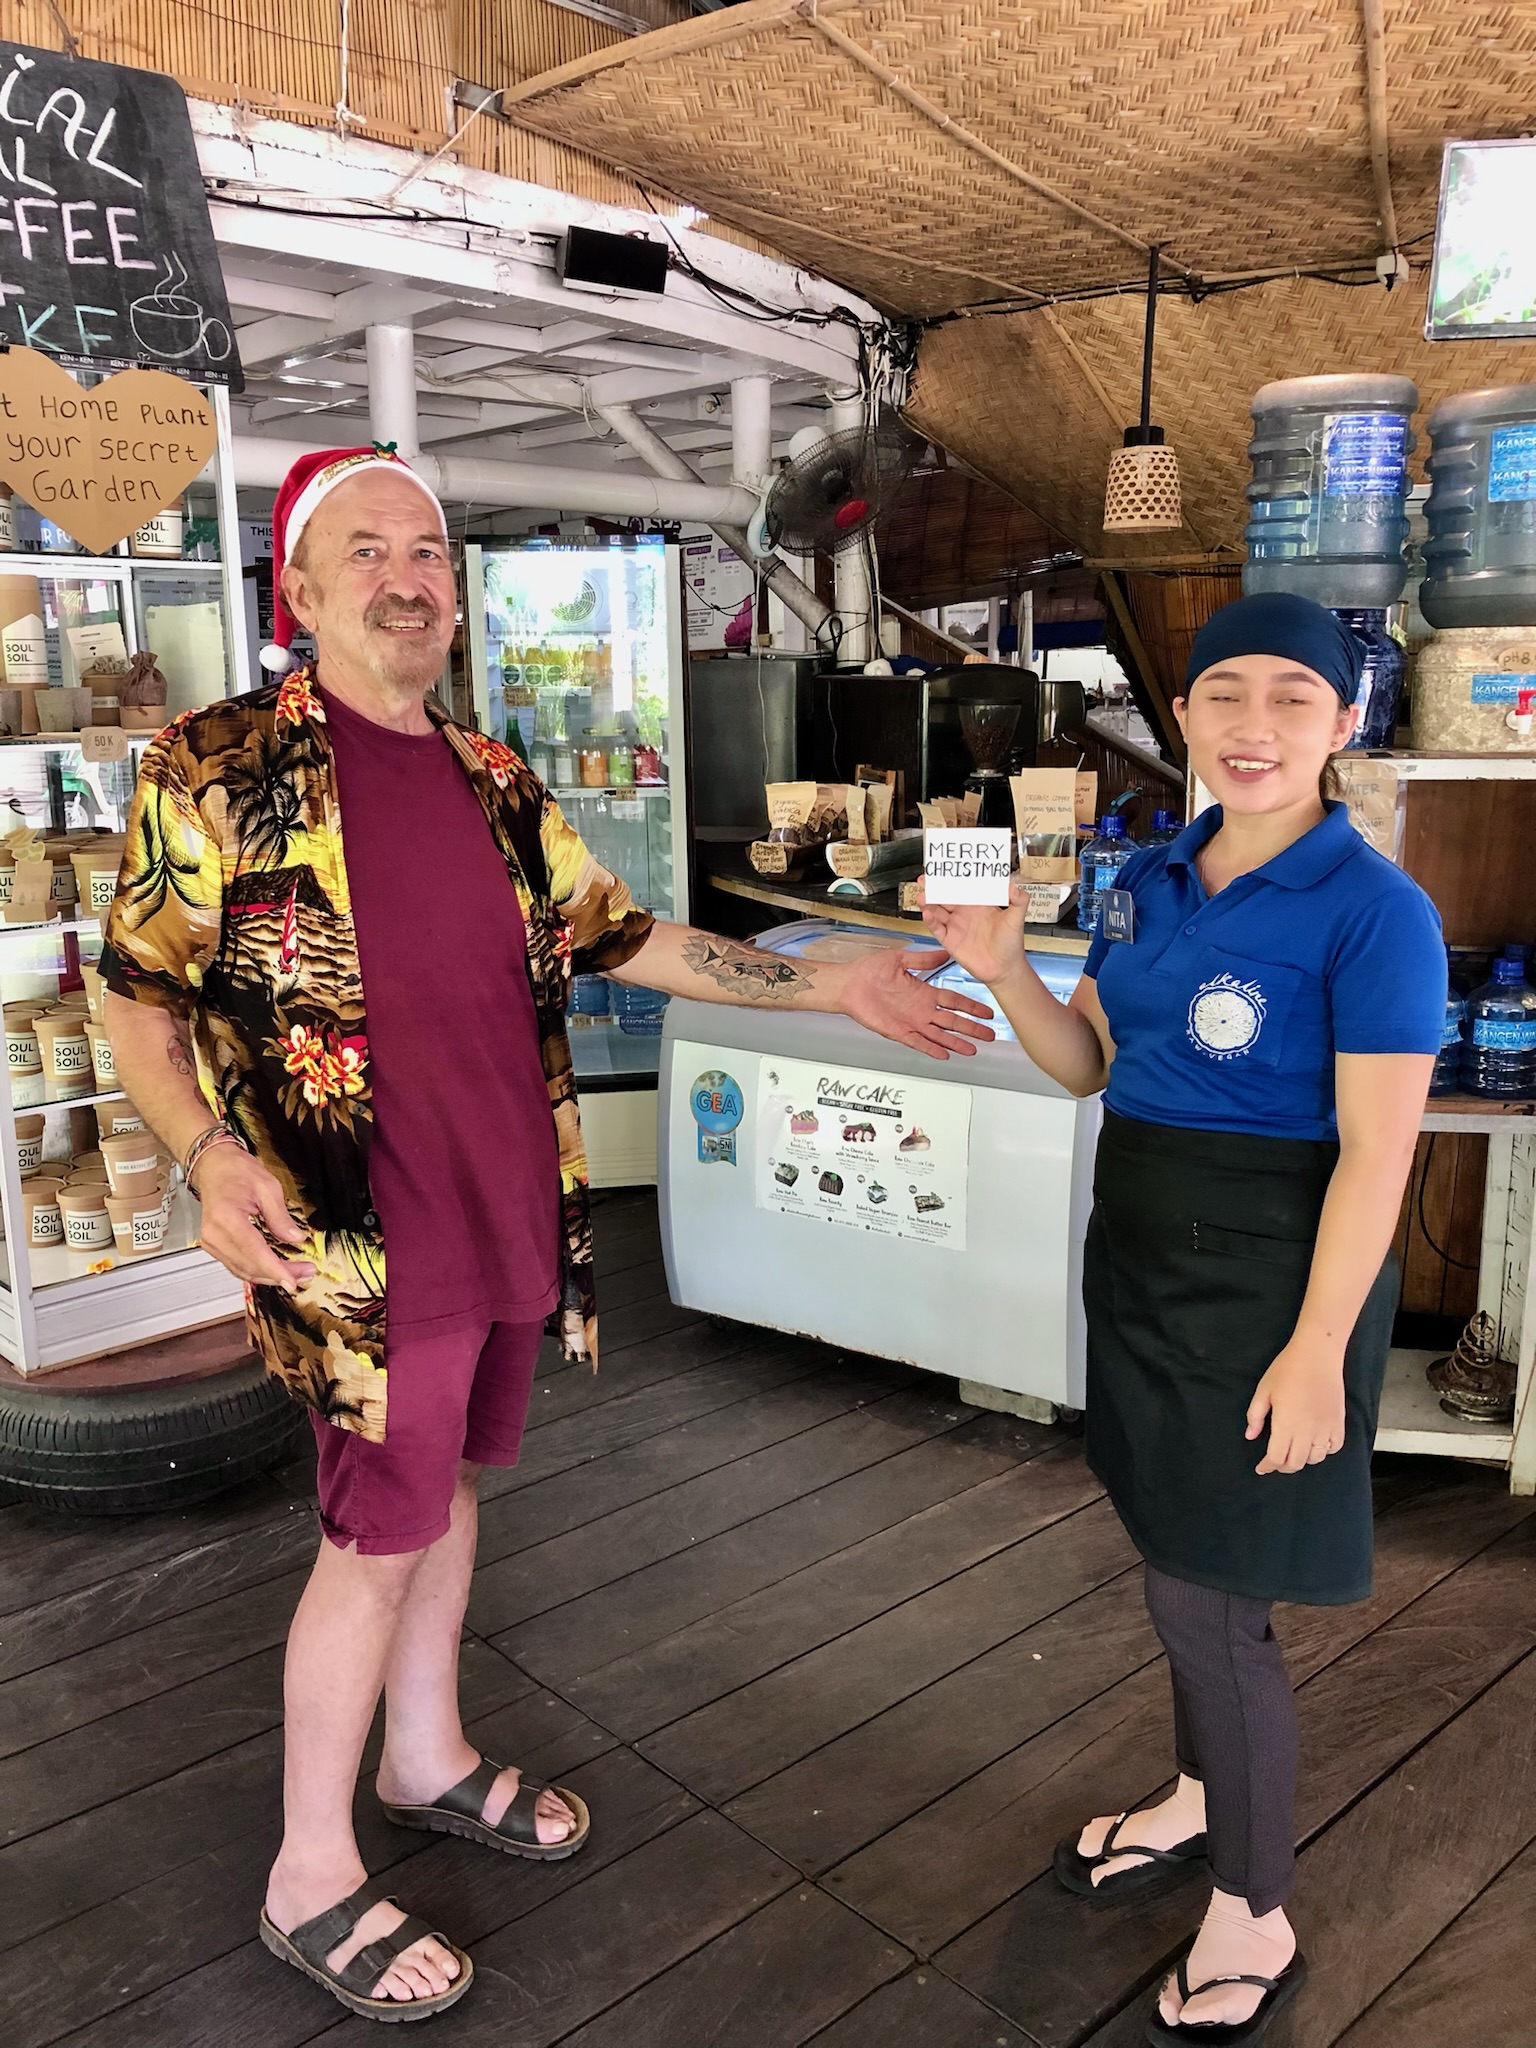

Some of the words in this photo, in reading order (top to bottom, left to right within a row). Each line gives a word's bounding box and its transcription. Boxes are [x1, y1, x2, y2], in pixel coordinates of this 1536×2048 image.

[40, 394, 119, 423] Home
[32, 469, 162, 503] Garden
[929, 842, 1005, 859] MERRY
[925, 861, 1010, 878] CHRISTMAS
[1108, 910, 1127, 930] NITA
[1475, 1029, 1520, 1042] KANGEN
[9, 1053, 32, 1063] OIL.
[816, 1077, 856, 1098] RAW
[856, 1085, 907, 1105] CAKE
[696, 1090, 738, 1117] GEA
